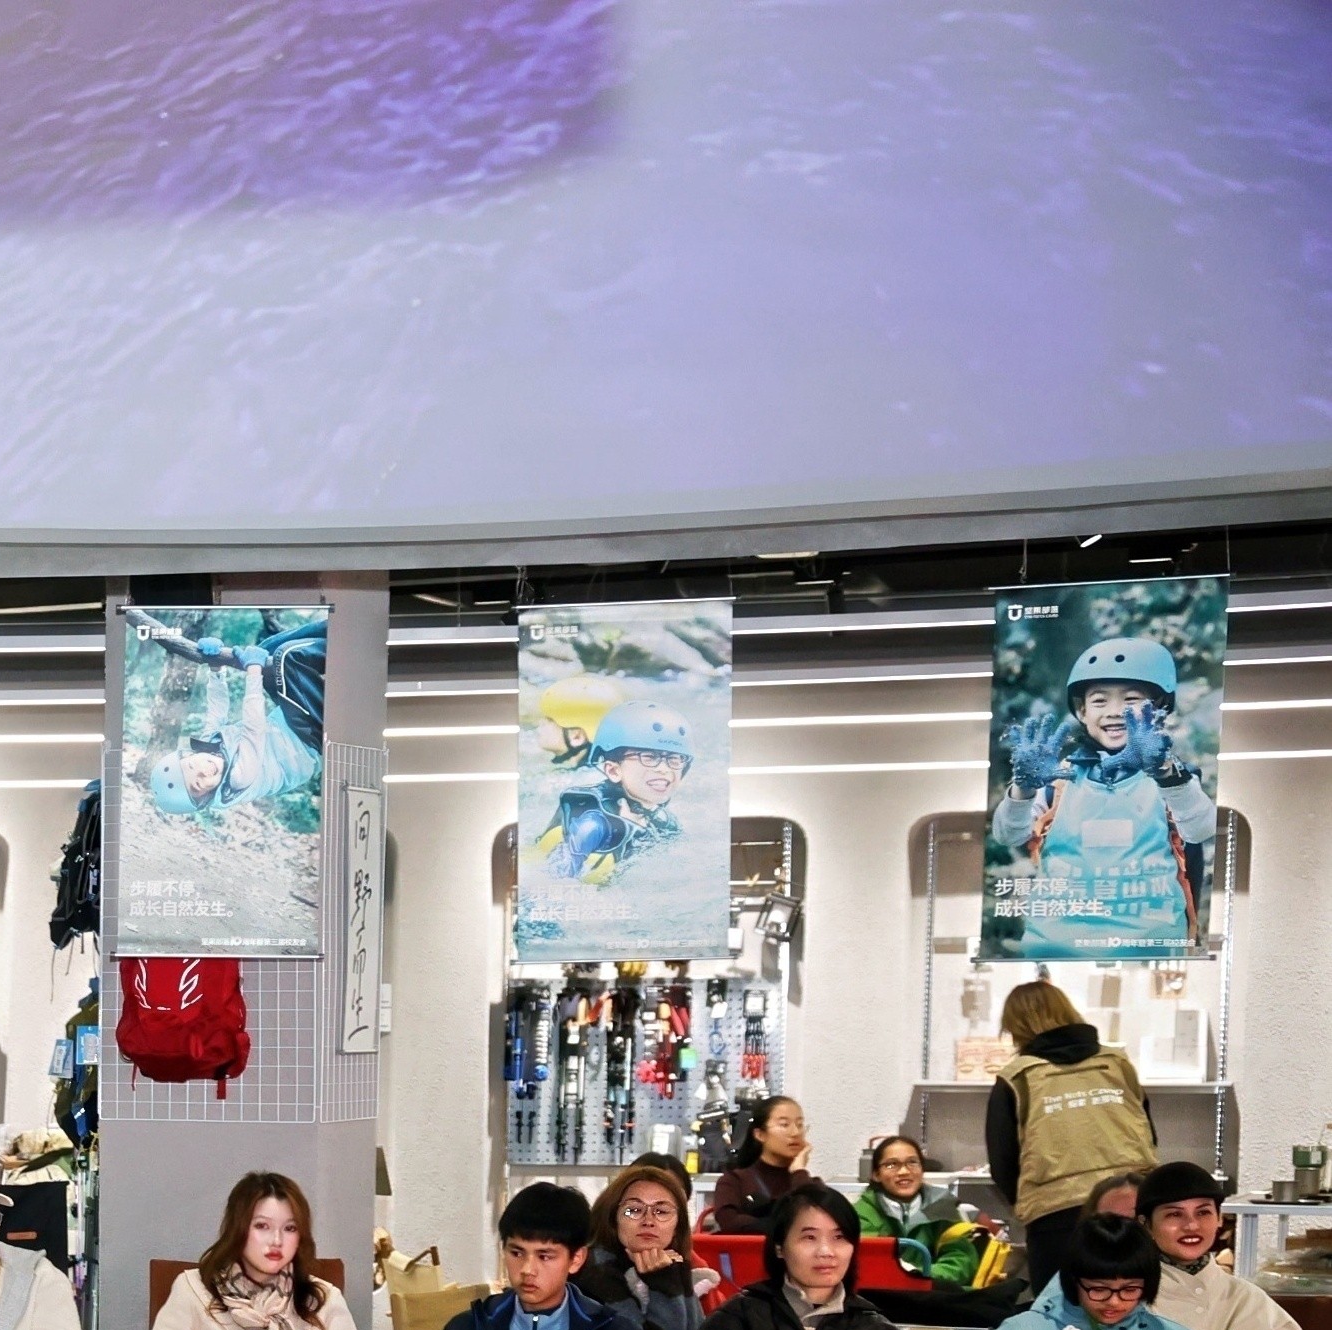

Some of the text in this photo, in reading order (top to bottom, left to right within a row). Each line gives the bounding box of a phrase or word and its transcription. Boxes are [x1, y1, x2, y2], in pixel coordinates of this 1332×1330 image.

[129, 900, 233, 918] 成长自然发生。
[994, 900, 1112, 917] 成长自然发生。
